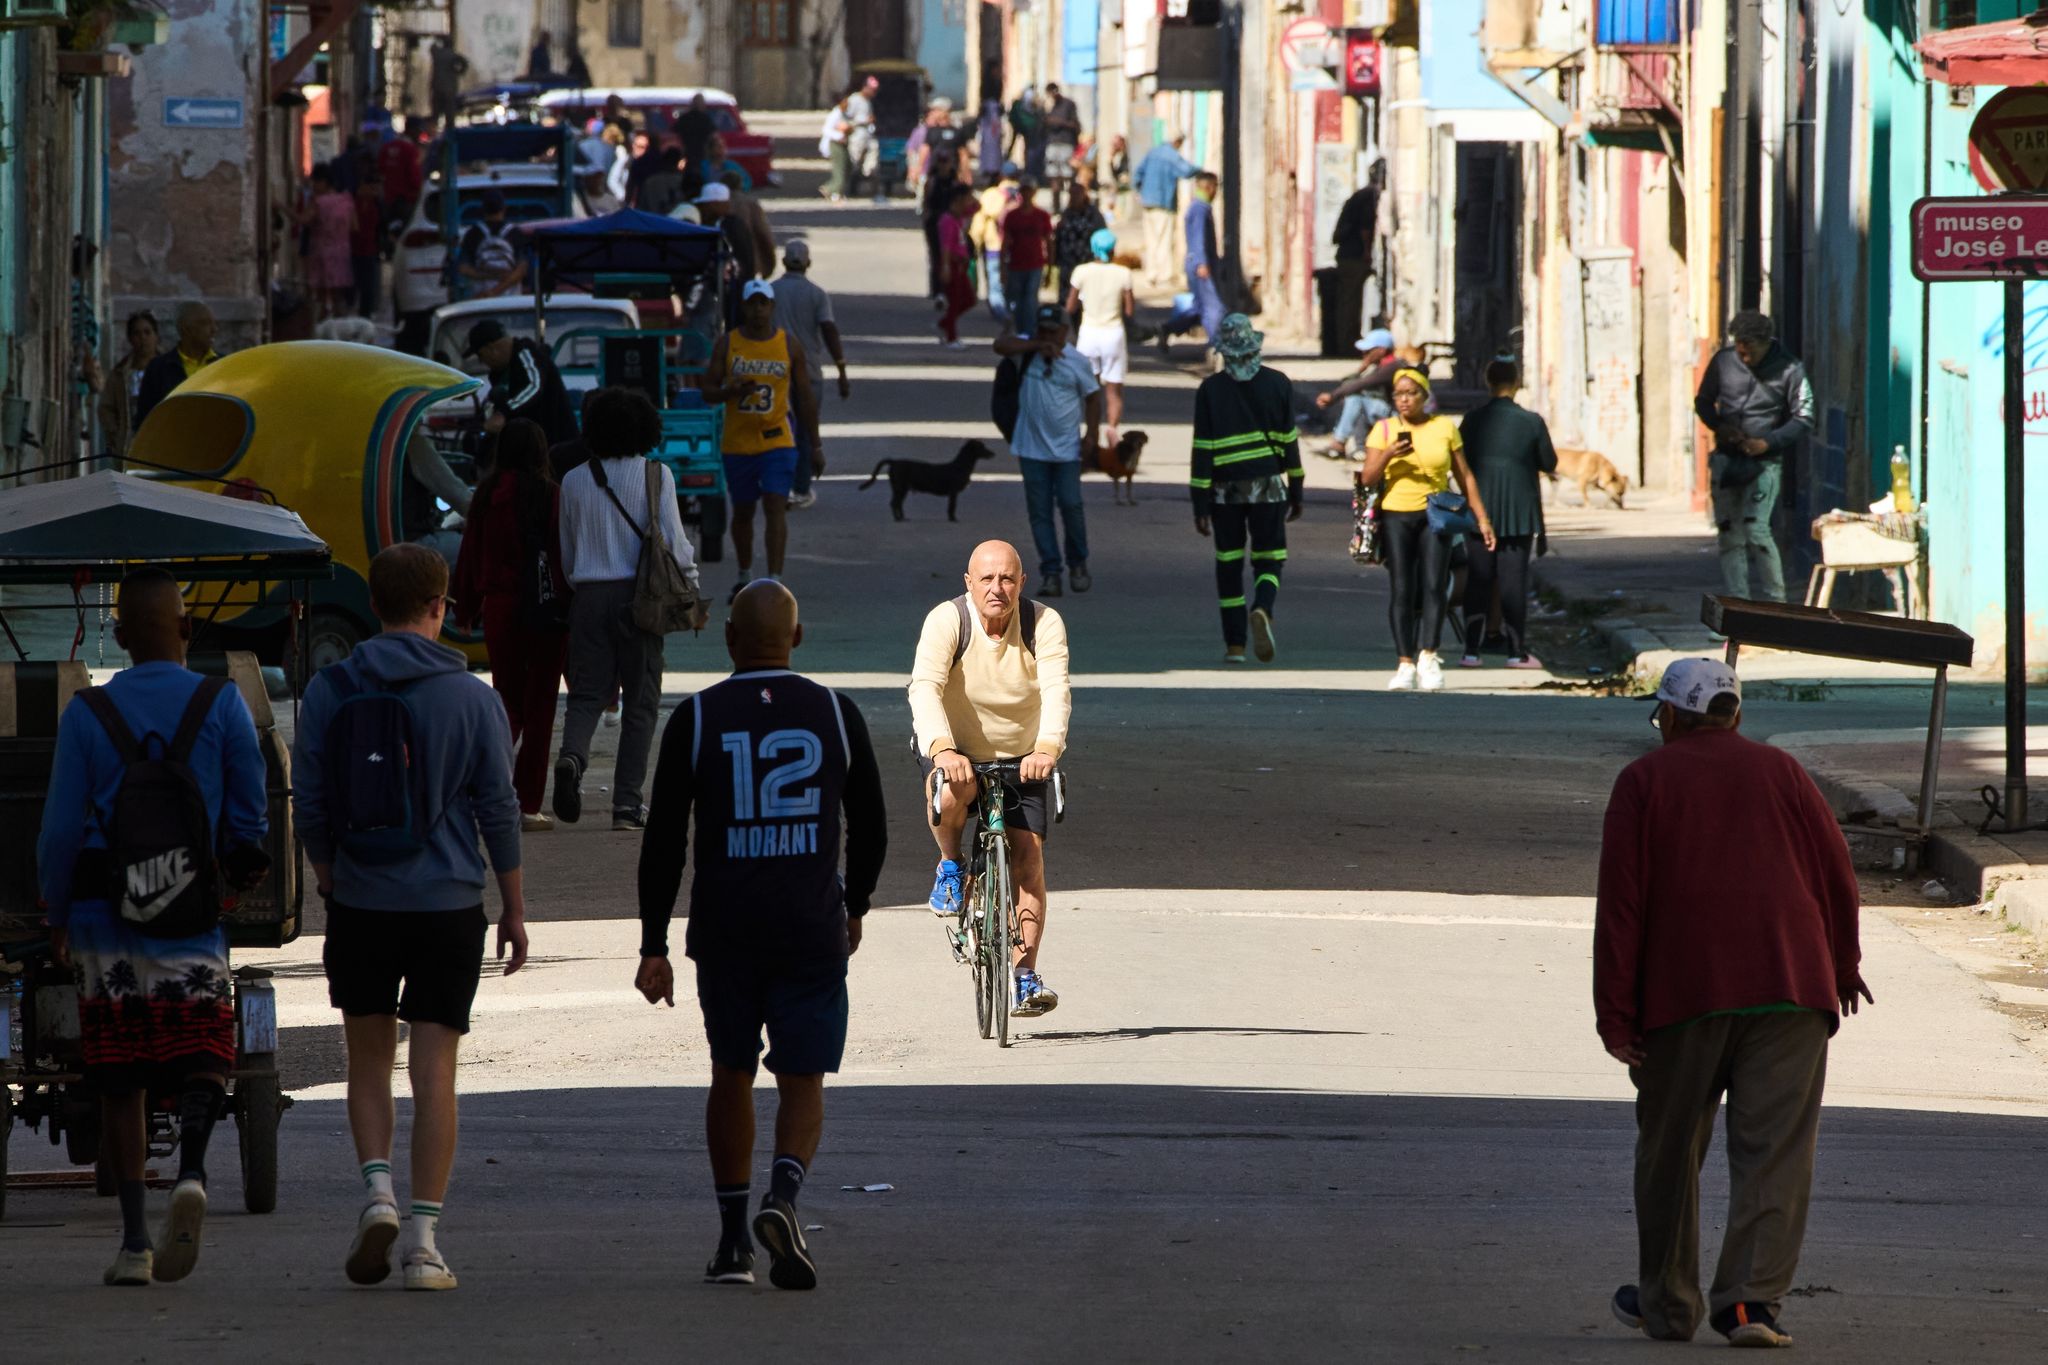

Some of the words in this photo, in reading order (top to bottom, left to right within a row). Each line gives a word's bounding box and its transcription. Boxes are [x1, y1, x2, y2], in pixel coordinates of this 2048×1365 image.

[2014, 130, 2048, 150] PAR
[1935, 215, 2023, 231] museo
[1935, 235, 2006, 257] José
[738, 384, 775, 414] 23
[721, 729, 822, 819] 12
[727, 822, 818, 858] MORANT
[127, 847, 191, 898] NIKE
